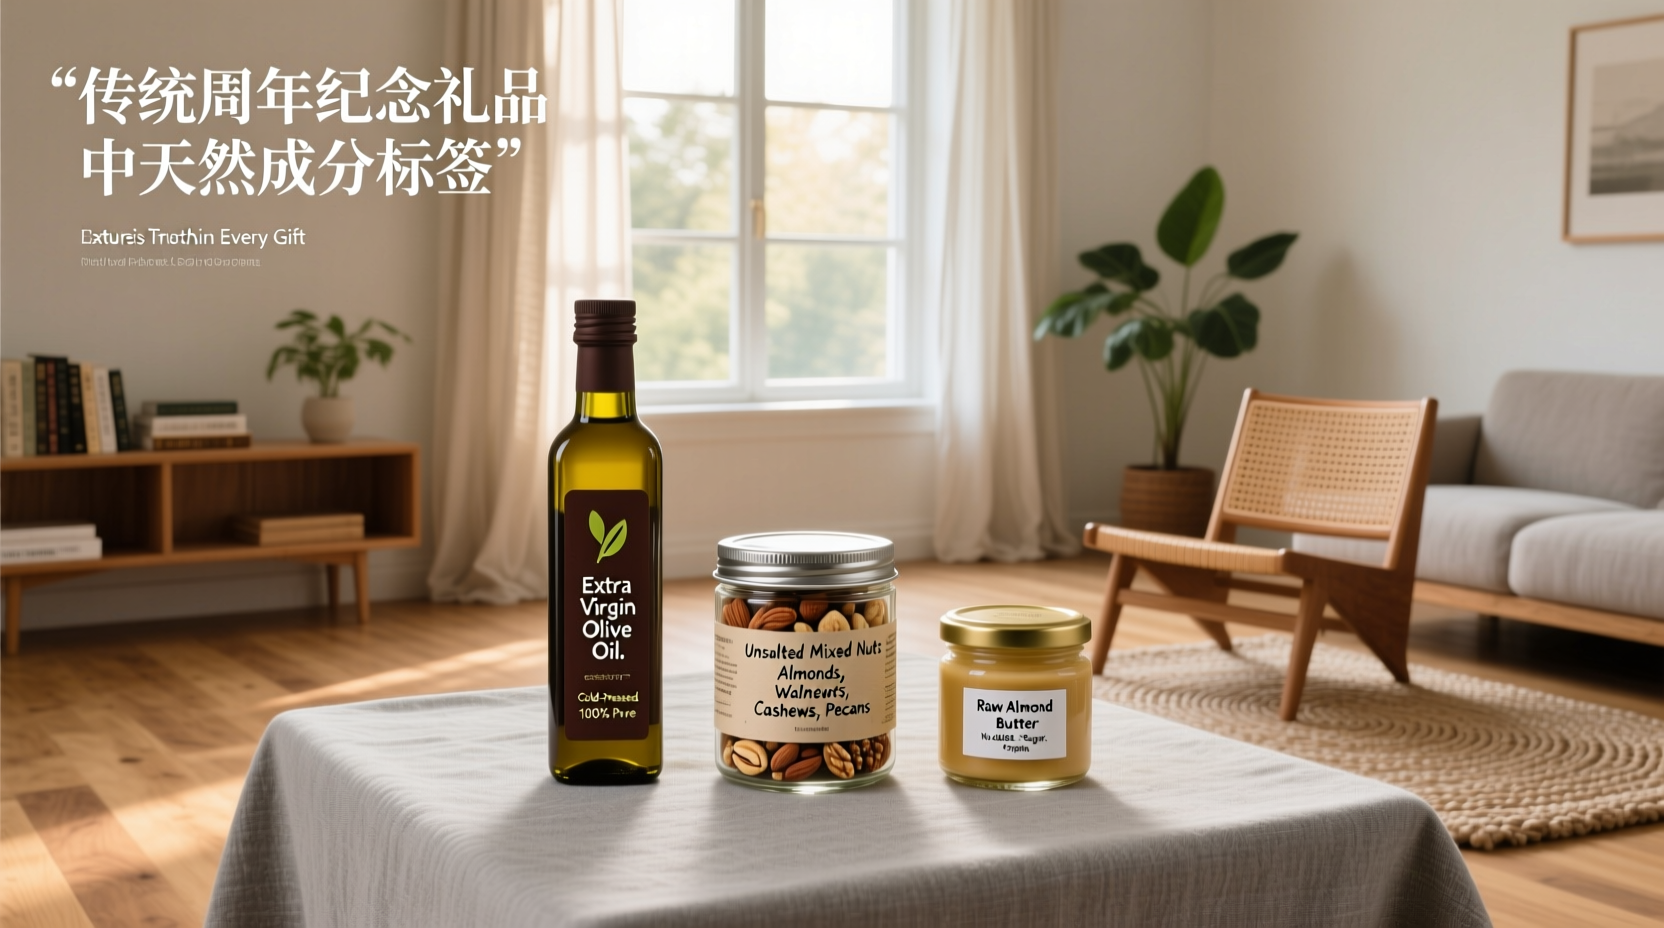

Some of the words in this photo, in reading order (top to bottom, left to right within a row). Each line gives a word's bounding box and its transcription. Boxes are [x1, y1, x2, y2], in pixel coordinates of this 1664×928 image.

[582, 576, 632, 594] Extra
[580, 597, 636, 621] Virgin
[582, 619, 632, 639] Olive
[592, 640, 625, 660] Oil.
[745, 643, 805, 660] Unsalted
[809, 640, 852, 659] Mixed
[777, 664, 845, 683] Almonds,
[579, 707, 610, 719] 100%
[754, 700, 820, 721] Cashews,
[825, 702, 871, 718] Pecans
[977, 699, 1003, 712] Raw
[1006, 699, 1053, 713] Almond
[996, 717, 1040, 729] Butter
